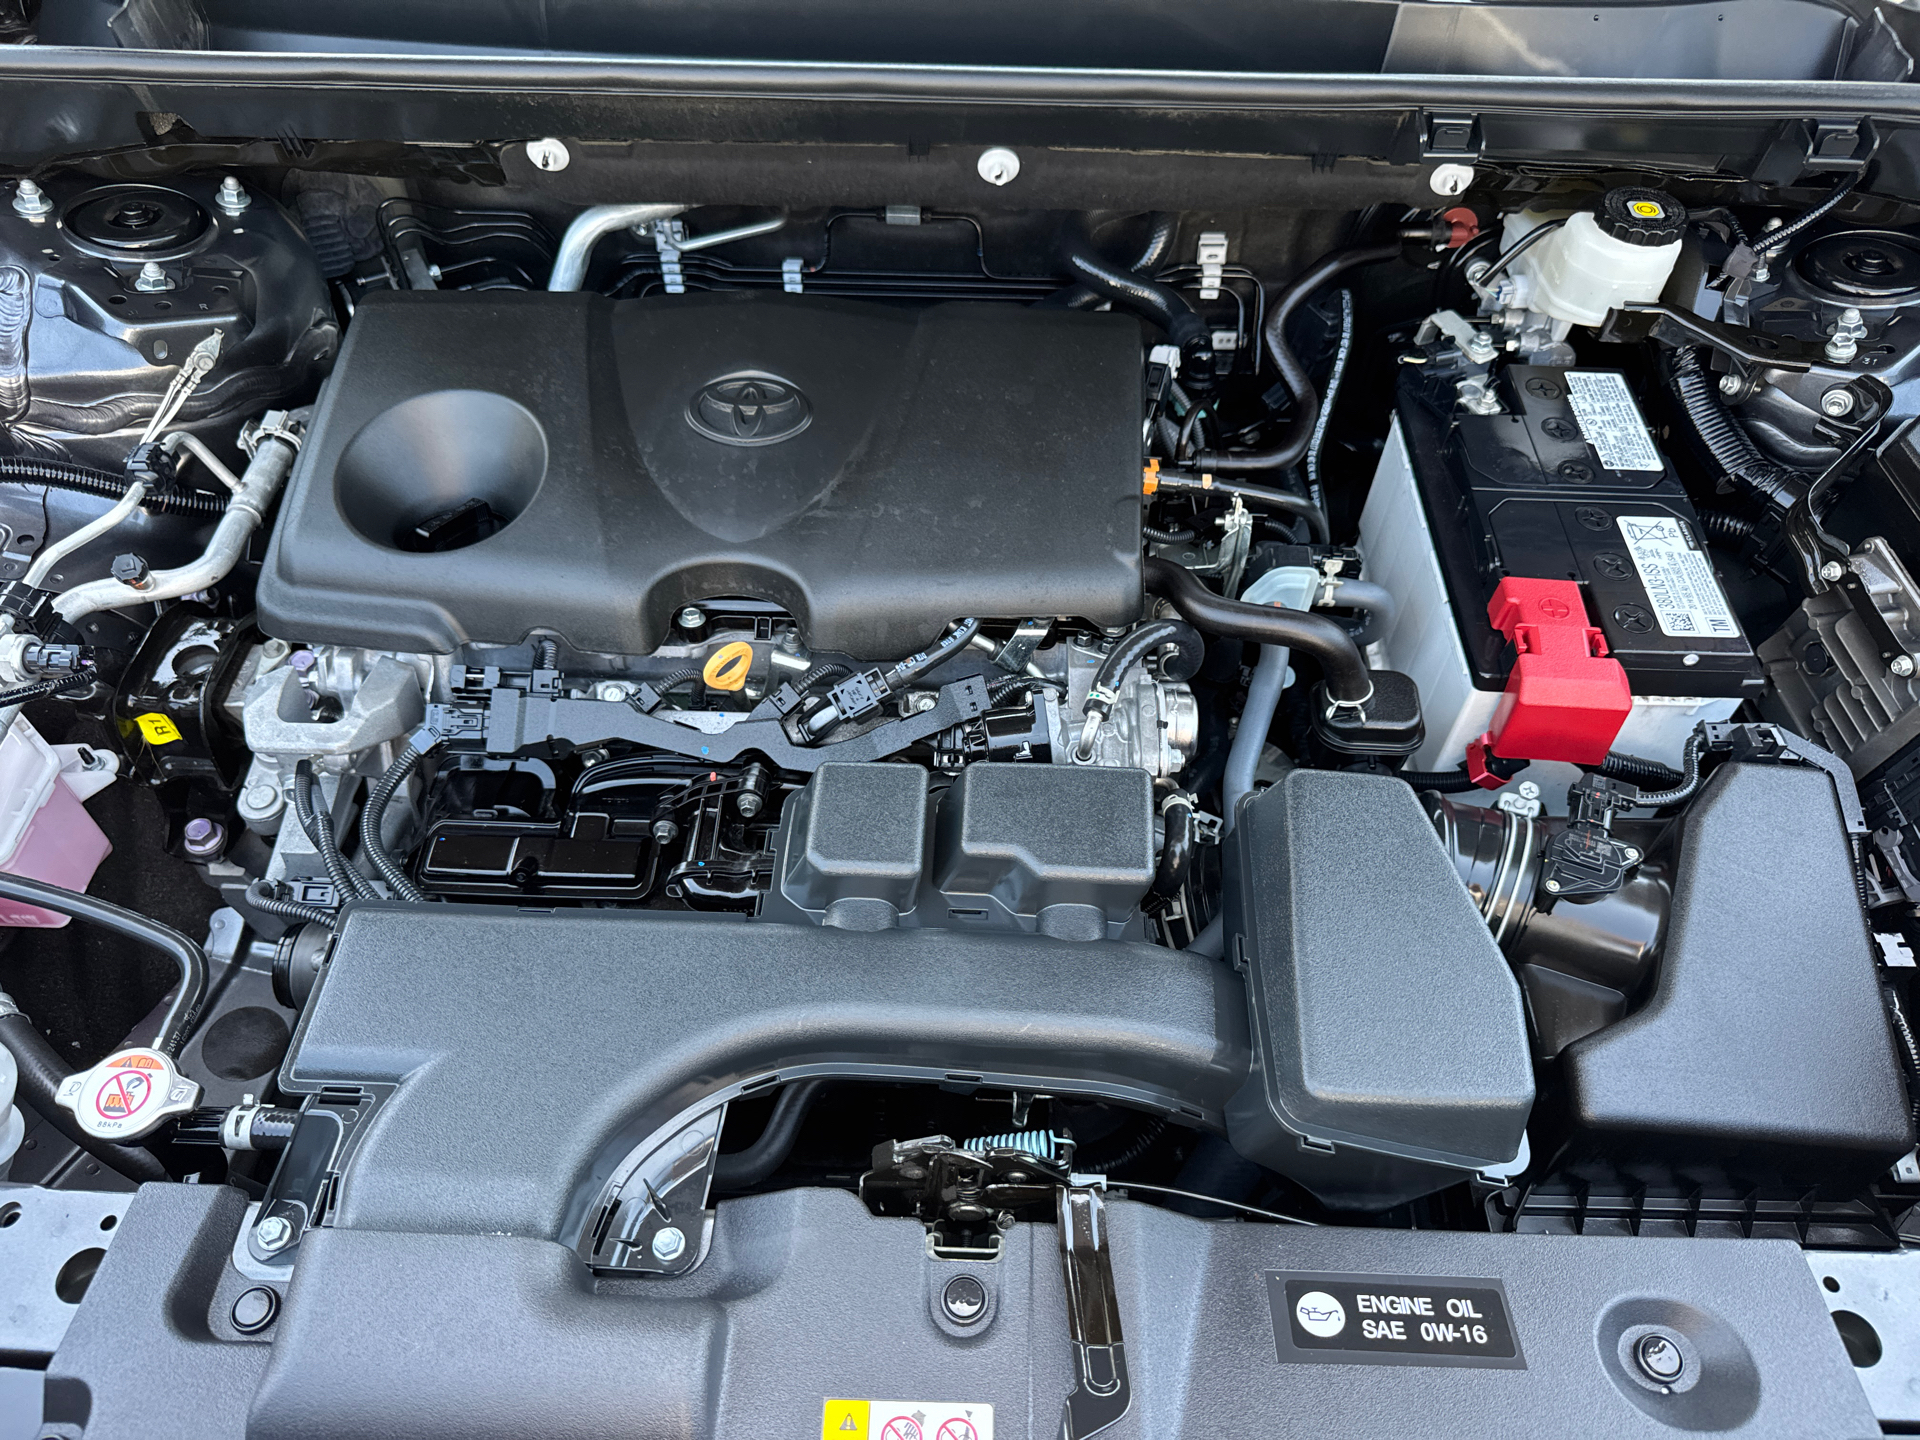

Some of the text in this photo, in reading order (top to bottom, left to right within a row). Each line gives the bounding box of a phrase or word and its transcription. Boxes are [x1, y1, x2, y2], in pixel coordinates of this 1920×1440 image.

[1667, 527, 1679, 538] Pb
[1641, 563, 1675, 609] 380LN3-ISS
[1709, 619, 1731, 633] TM
[148, 719, 171, 736] R1
[97, 1120, 123, 1129] 88kPa
[1356, 1294, 1483, 1319] ENGINE OIL
[1362, 1319, 1488, 1345] SAE 0W-16
